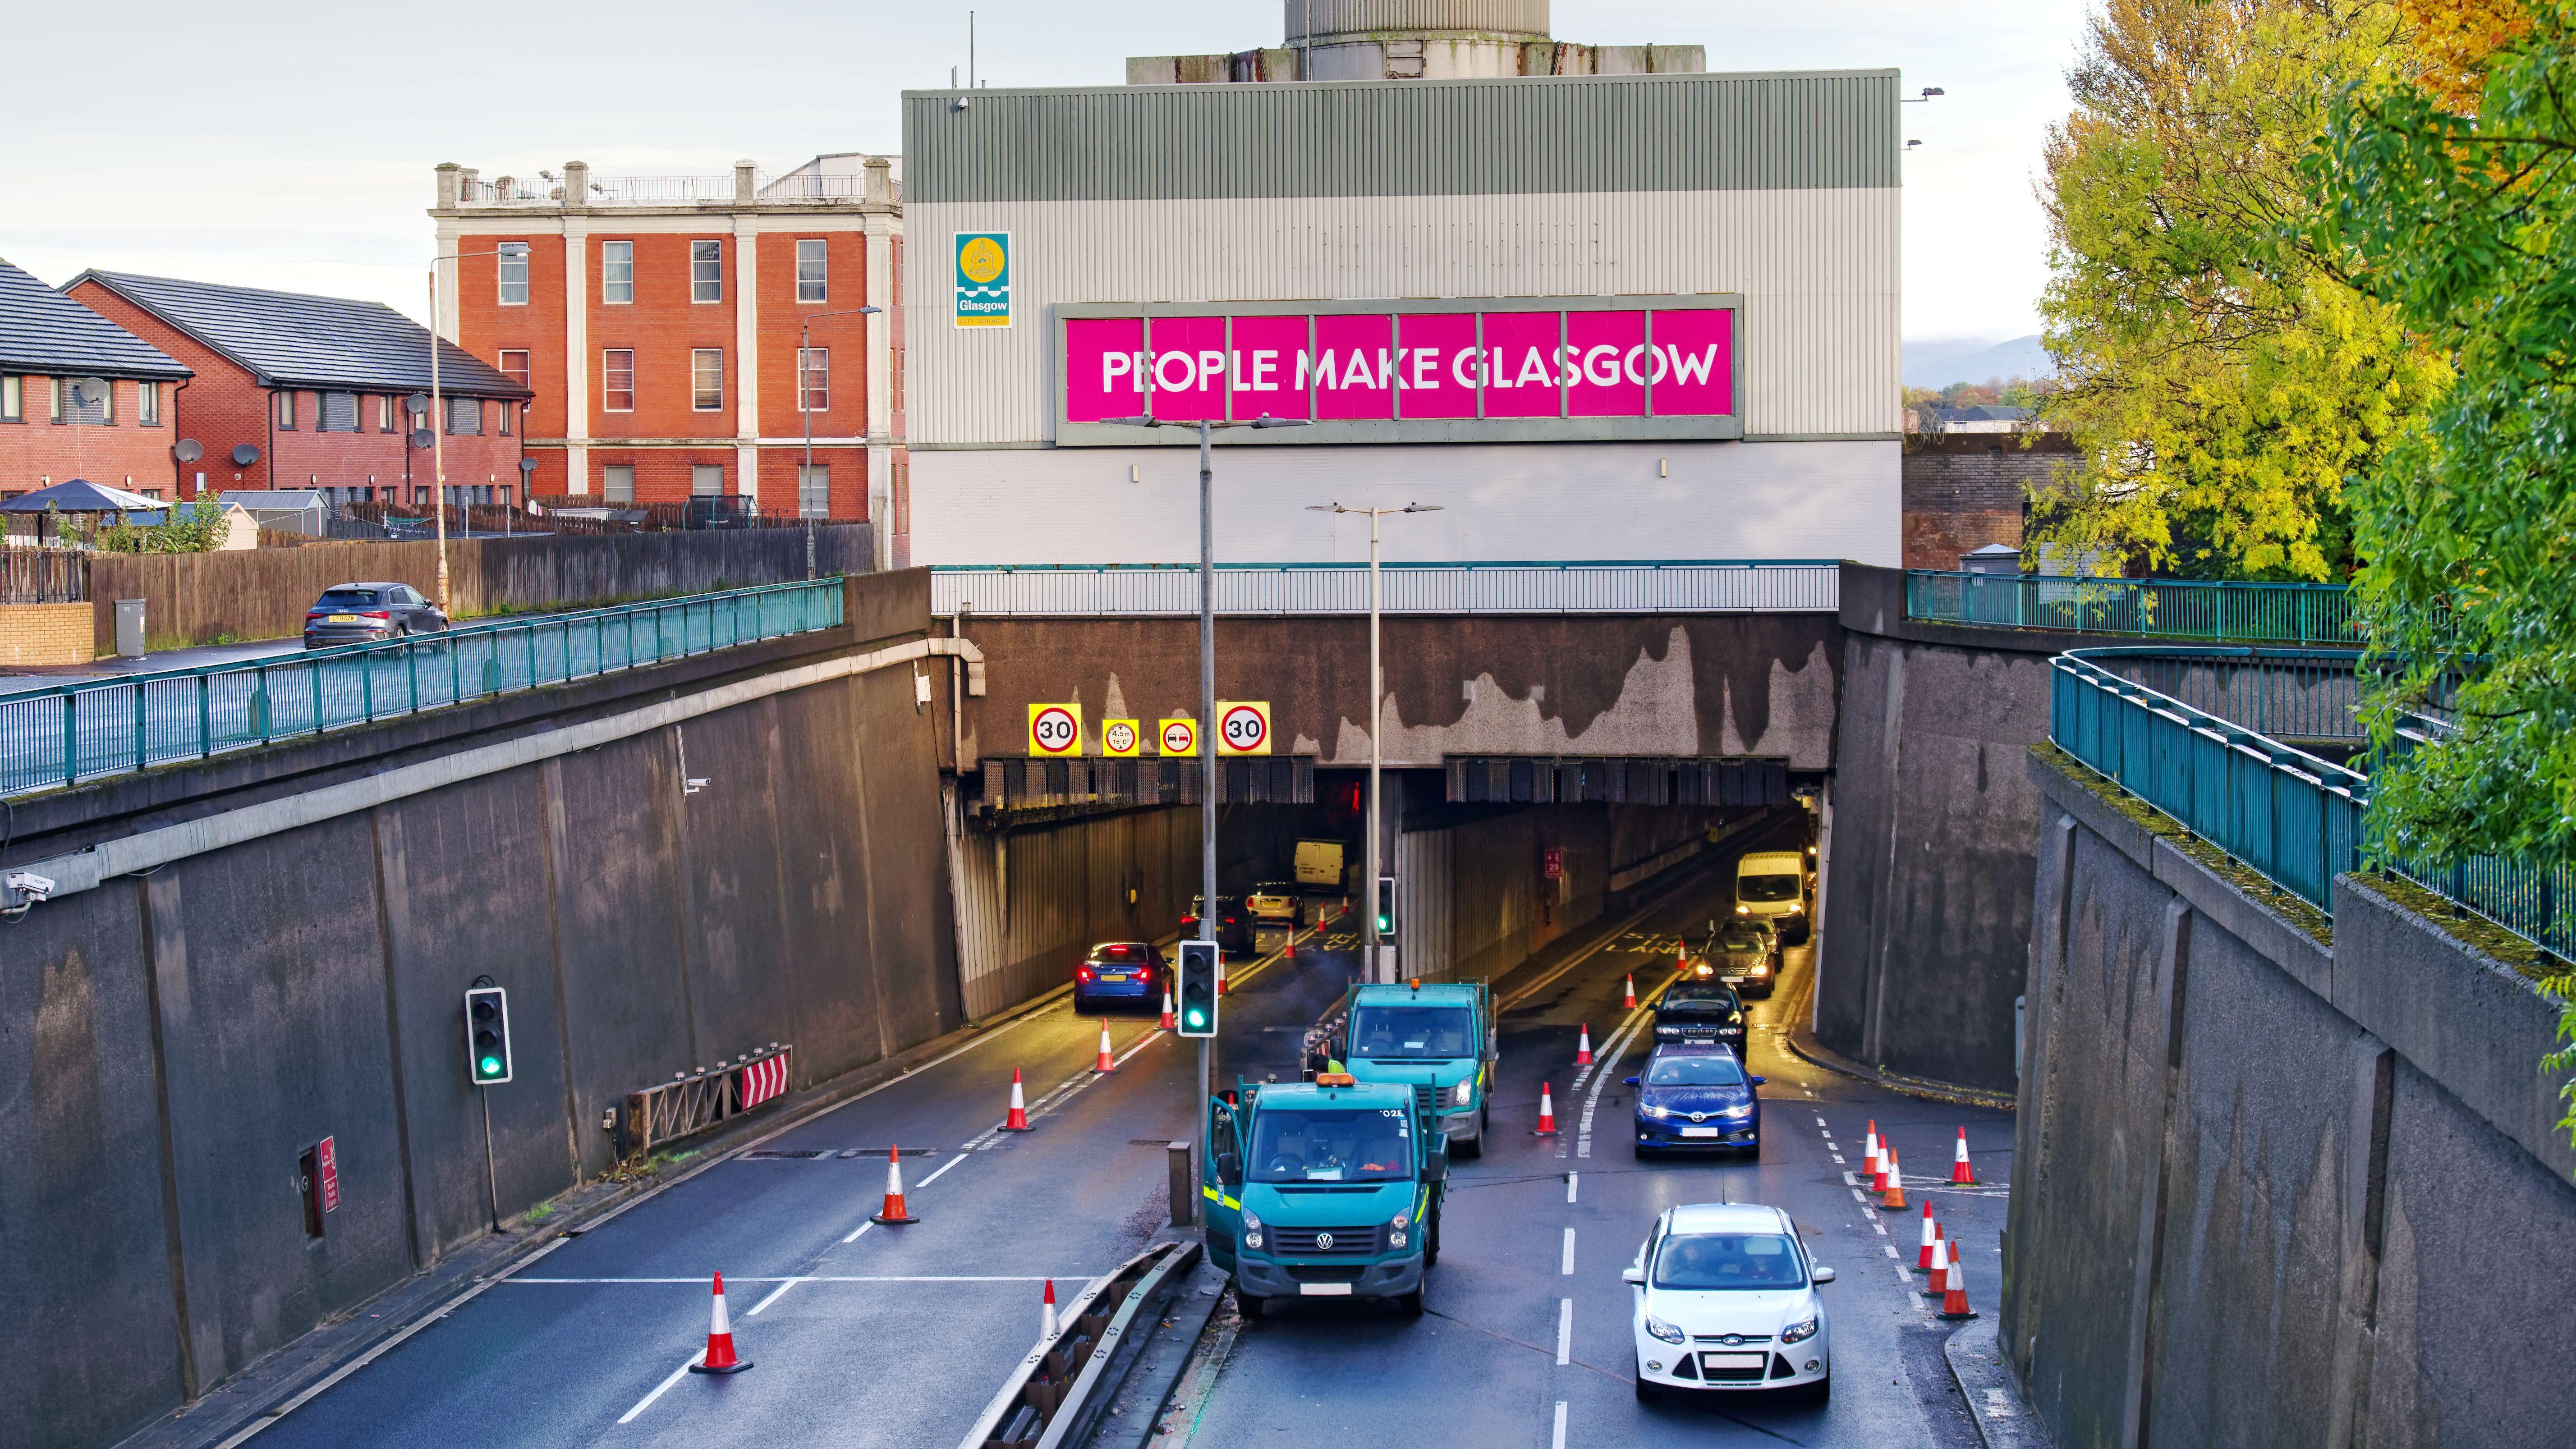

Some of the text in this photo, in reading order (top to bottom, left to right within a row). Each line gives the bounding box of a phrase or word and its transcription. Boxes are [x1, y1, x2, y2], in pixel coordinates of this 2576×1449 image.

[960, 300, 1007, 312] Glasgow
[1103, 344, 1717, 393] PEOPLE MAKE GLASGOW
[1039, 721, 1071, 739] 30
[1228, 720, 1260, 738] 30
